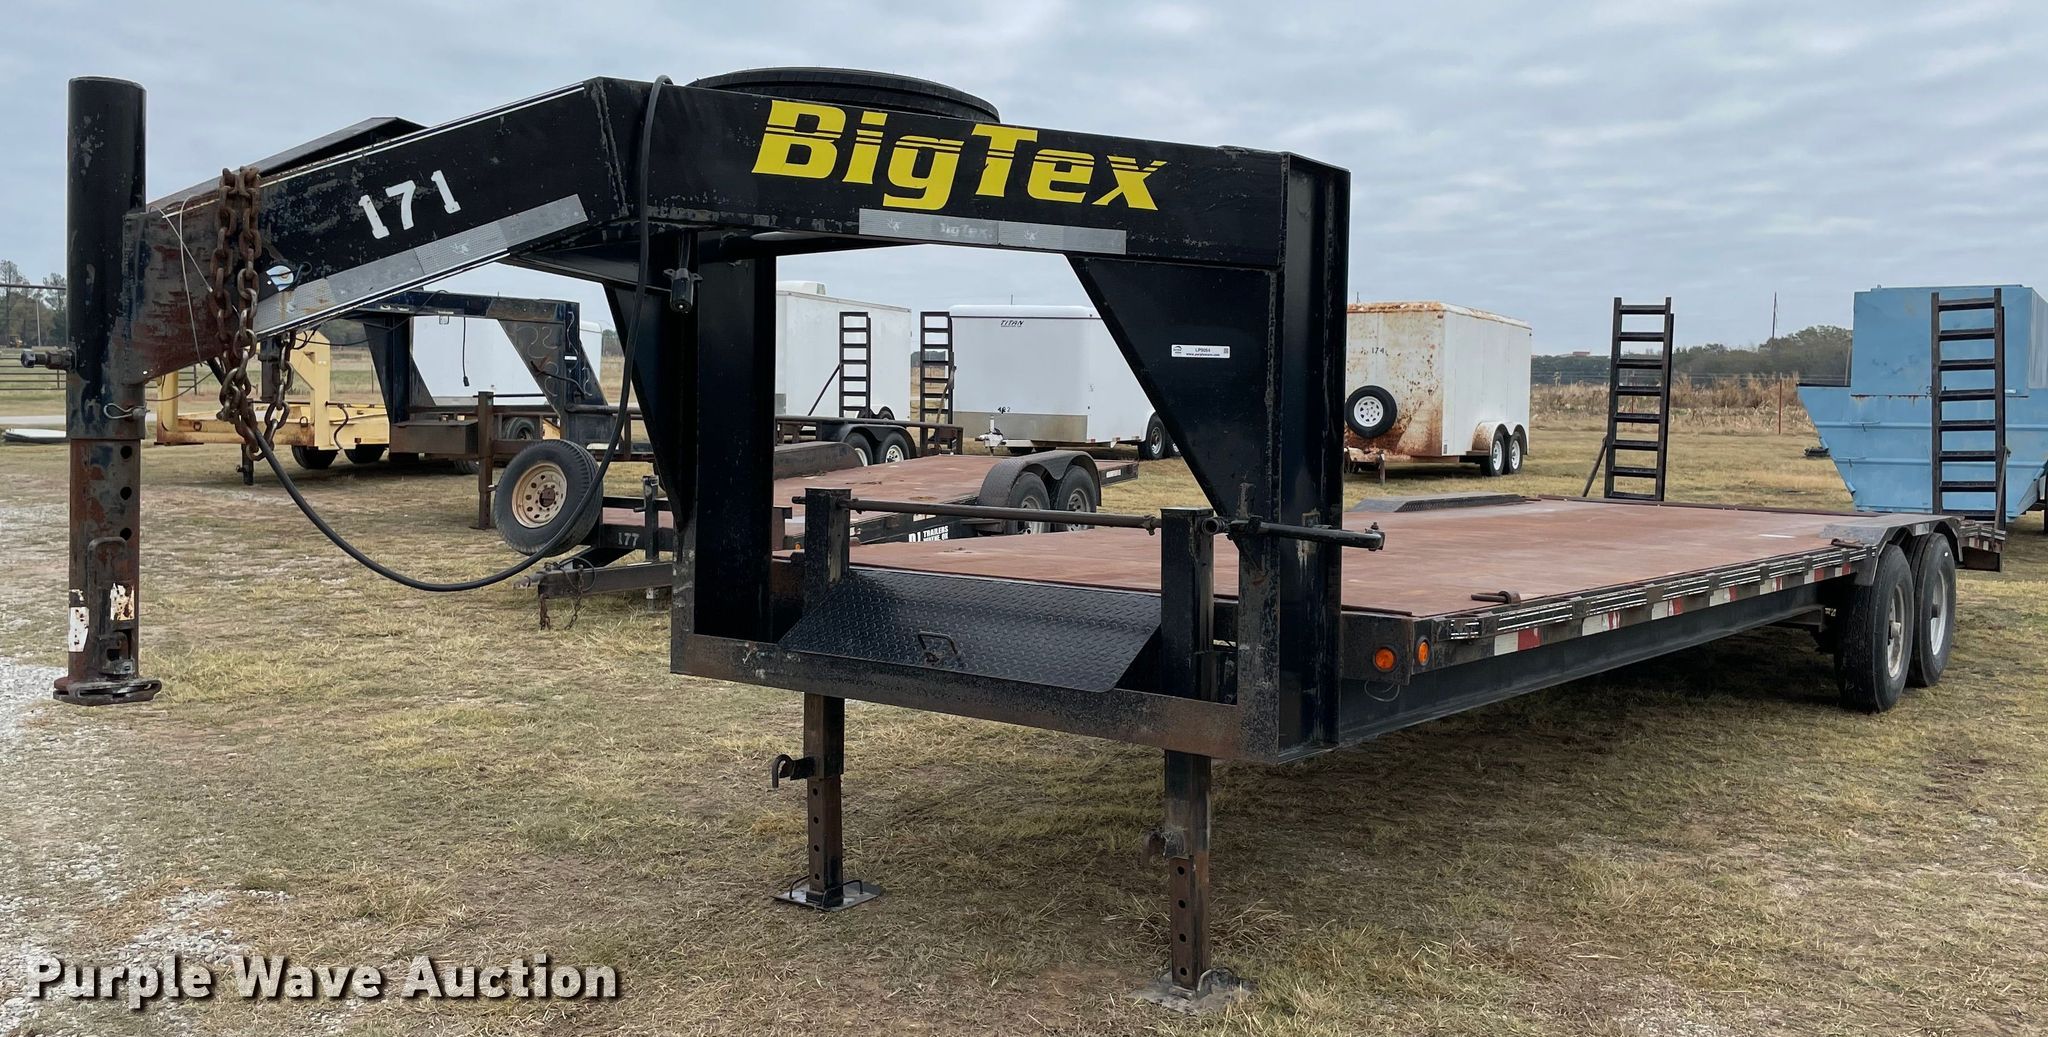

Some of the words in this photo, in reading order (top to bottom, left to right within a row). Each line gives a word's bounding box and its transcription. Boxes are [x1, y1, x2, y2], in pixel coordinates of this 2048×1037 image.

[752, 99, 1166, 211] BigTex
[358, 169, 462, 240] 171
[1371, 346, 1385, 354] 174
[923, 525, 949, 538] TRAILERS
[618, 532, 640, 548] 177
